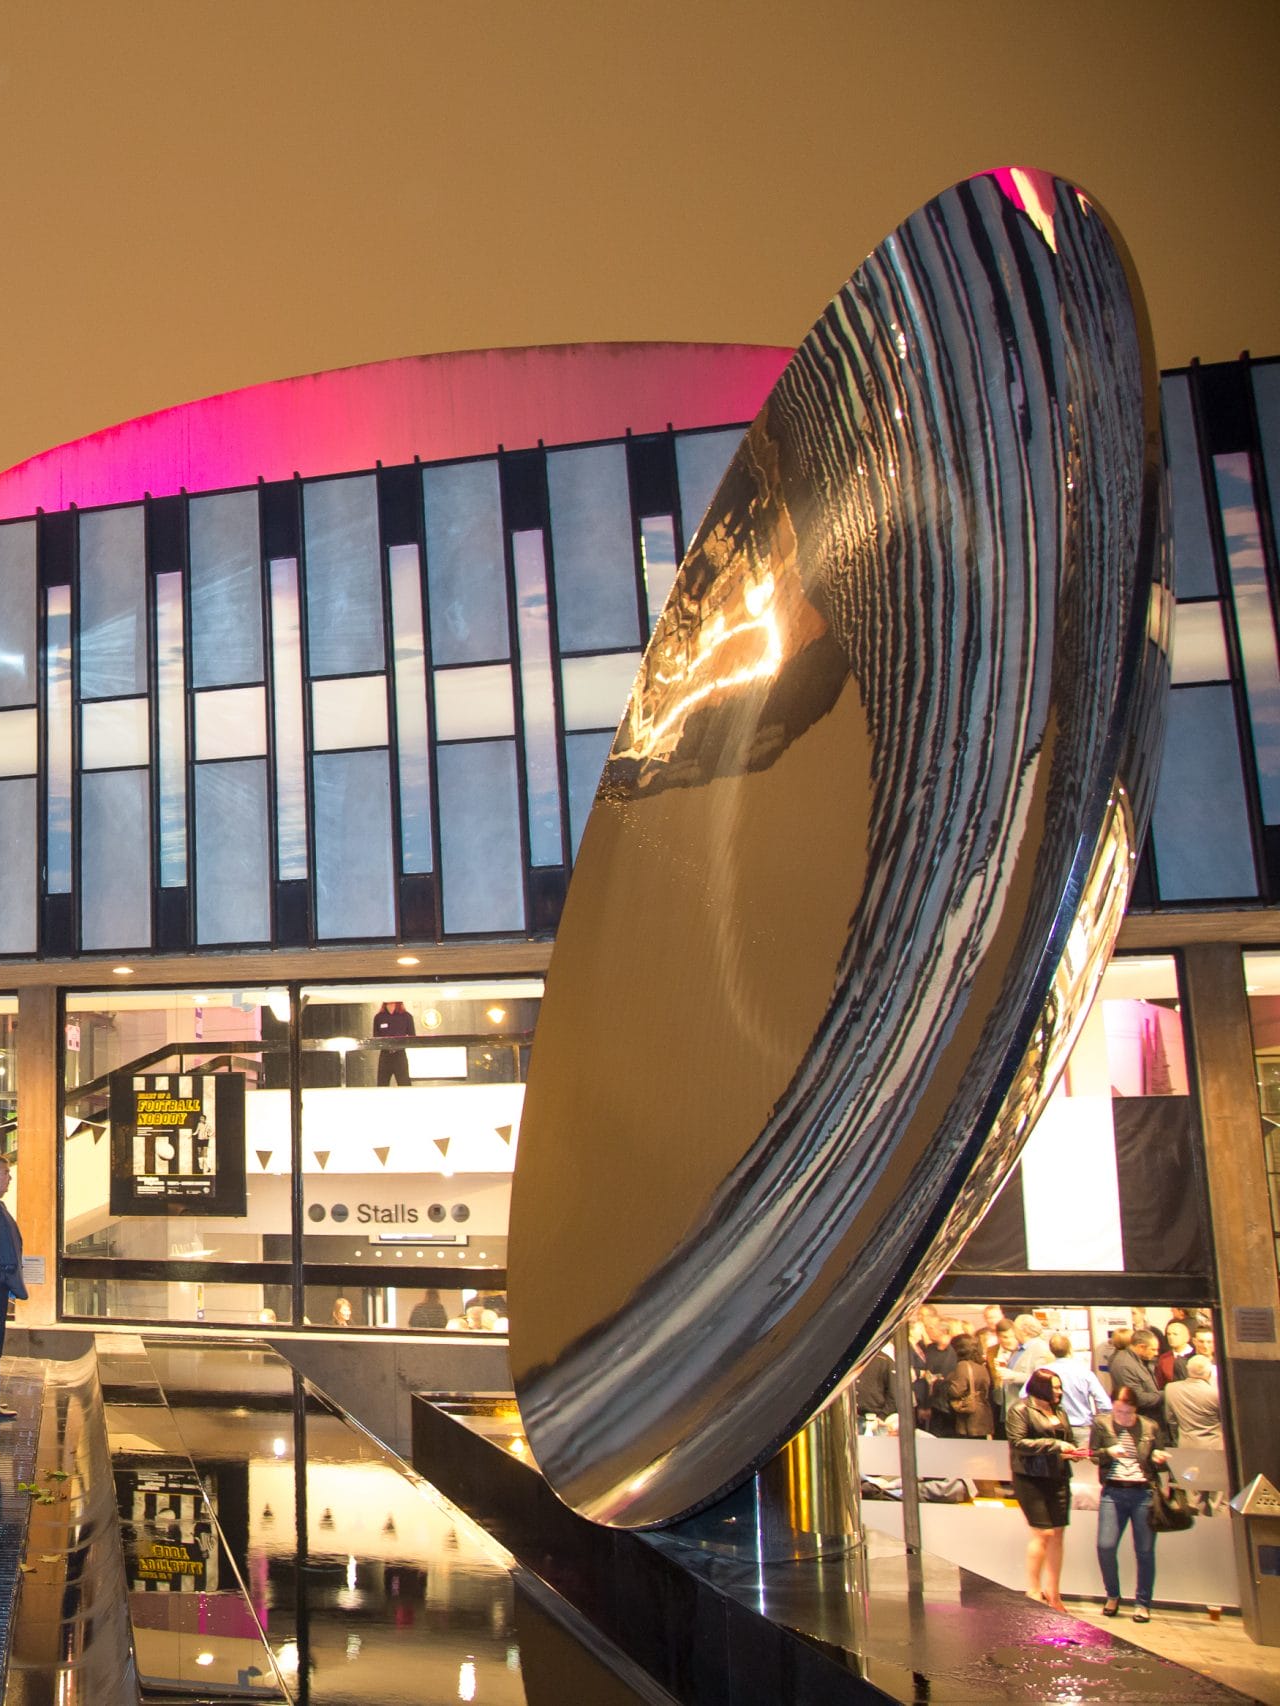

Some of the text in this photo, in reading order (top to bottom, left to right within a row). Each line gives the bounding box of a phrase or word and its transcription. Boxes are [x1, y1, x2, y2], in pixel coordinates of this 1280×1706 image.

[137, 1100, 200, 1113] FOOTBALL
[137, 1113, 188, 1126] NOBODY
[357, 1203, 419, 1224] Stalls
